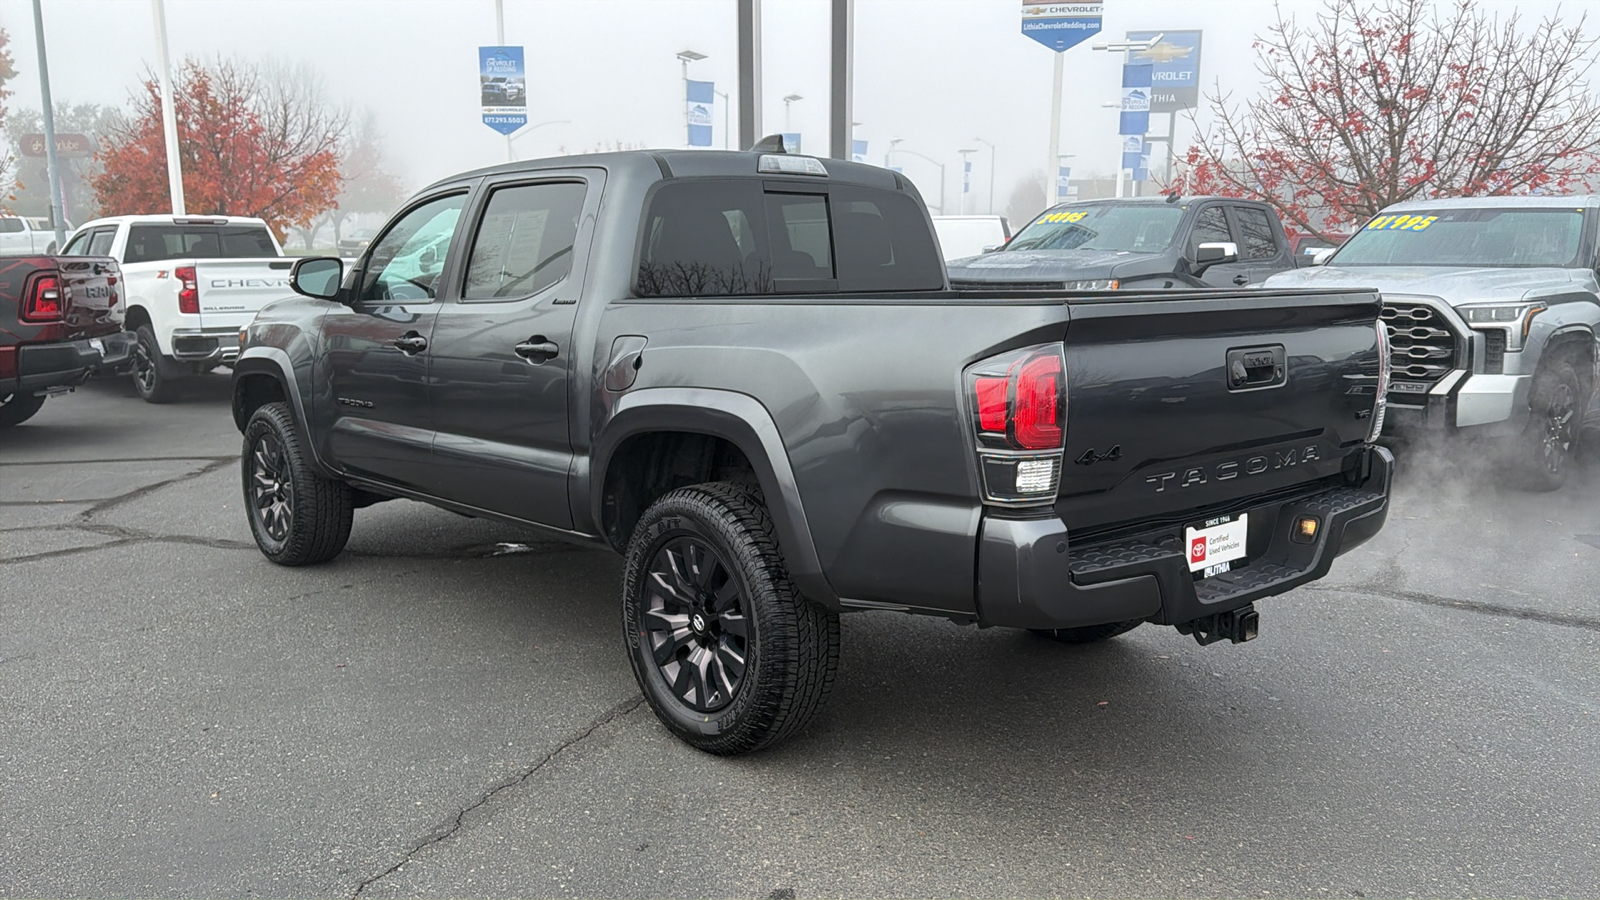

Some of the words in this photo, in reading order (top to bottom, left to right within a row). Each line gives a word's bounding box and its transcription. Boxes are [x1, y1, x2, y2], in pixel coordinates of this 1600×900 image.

[1023, 22, 1100, 31] LithiaChevroletRedding.com
[1152, 71, 1193, 80] VROLET
[1150, 94, 1176, 103] THIA
[211, 279, 291, 288] CHEVR
[1146, 444, 1320, 493] TACOMA
[1205, 517, 1219, 527] SINCE
[1209, 533, 1229, 545] Certified
[1209, 546, 1221, 556] Used
[1222, 540, 1240, 553] Vehicles
